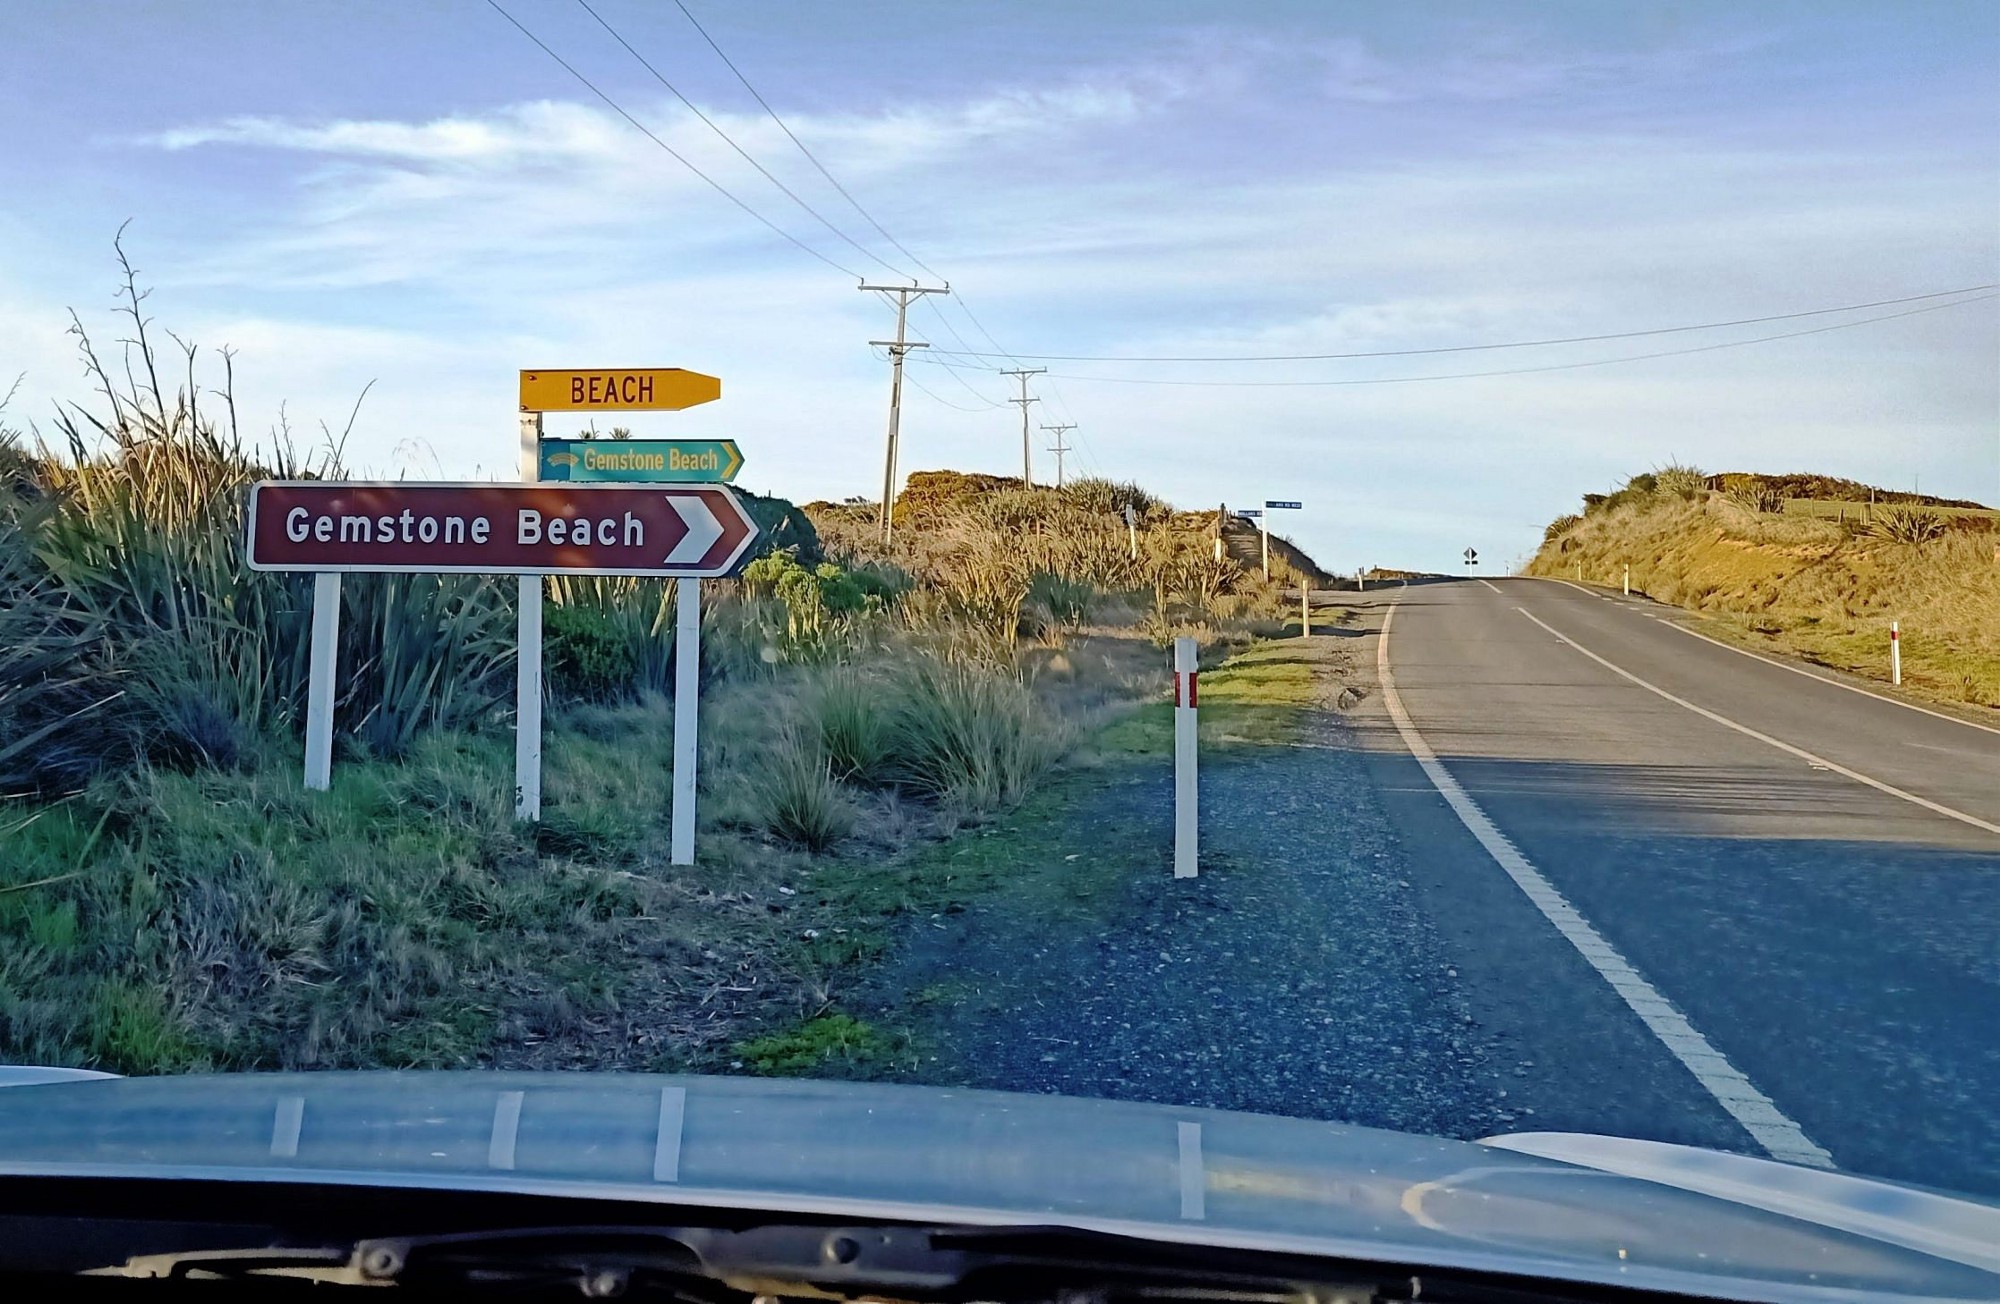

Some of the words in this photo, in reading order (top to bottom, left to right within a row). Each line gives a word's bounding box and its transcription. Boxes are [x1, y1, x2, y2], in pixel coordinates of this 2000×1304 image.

[571, 376, 654, 404] BEACH
[583, 448, 664, 471] Gemstone
[669, 448, 718, 471] Beach
[286, 506, 491, 544] Gemstone
[517, 509, 645, 547] Beach
